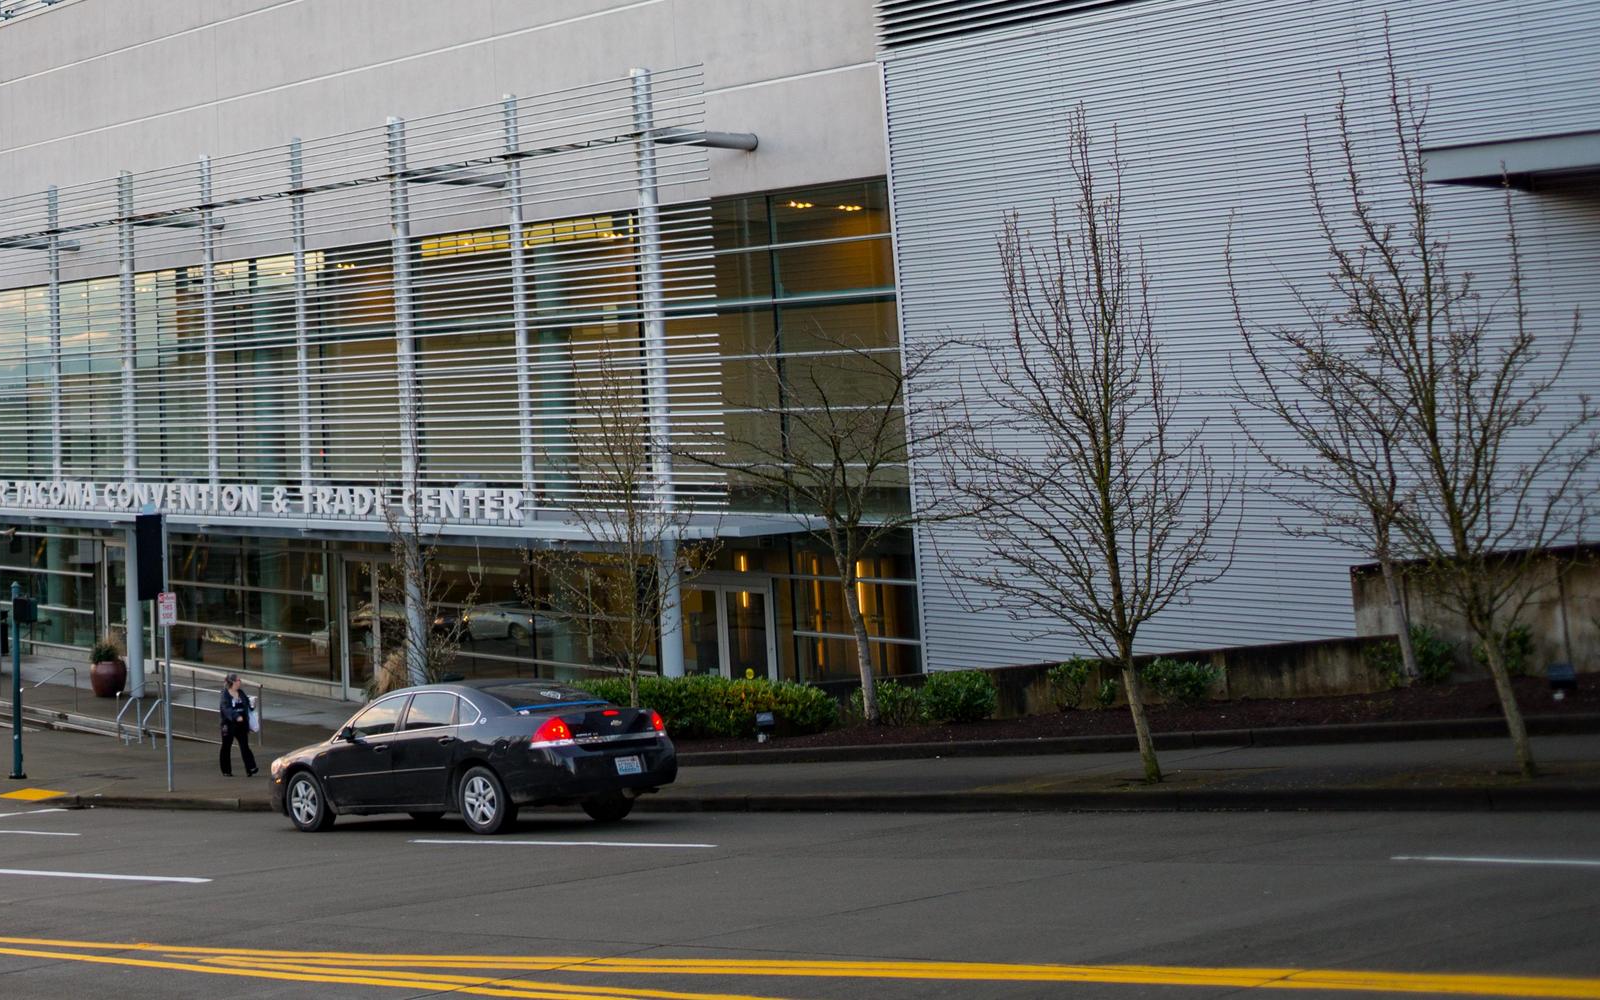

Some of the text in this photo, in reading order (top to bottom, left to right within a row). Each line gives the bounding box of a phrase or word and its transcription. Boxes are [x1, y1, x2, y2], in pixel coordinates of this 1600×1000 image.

[16, 481, 98, 507] TACOMA
[103, 483, 262, 512] CONVENTION
[271, 486, 290, 513] &
[301, 486, 387, 516] TRADE
[401, 488, 524, 520] CENTER
